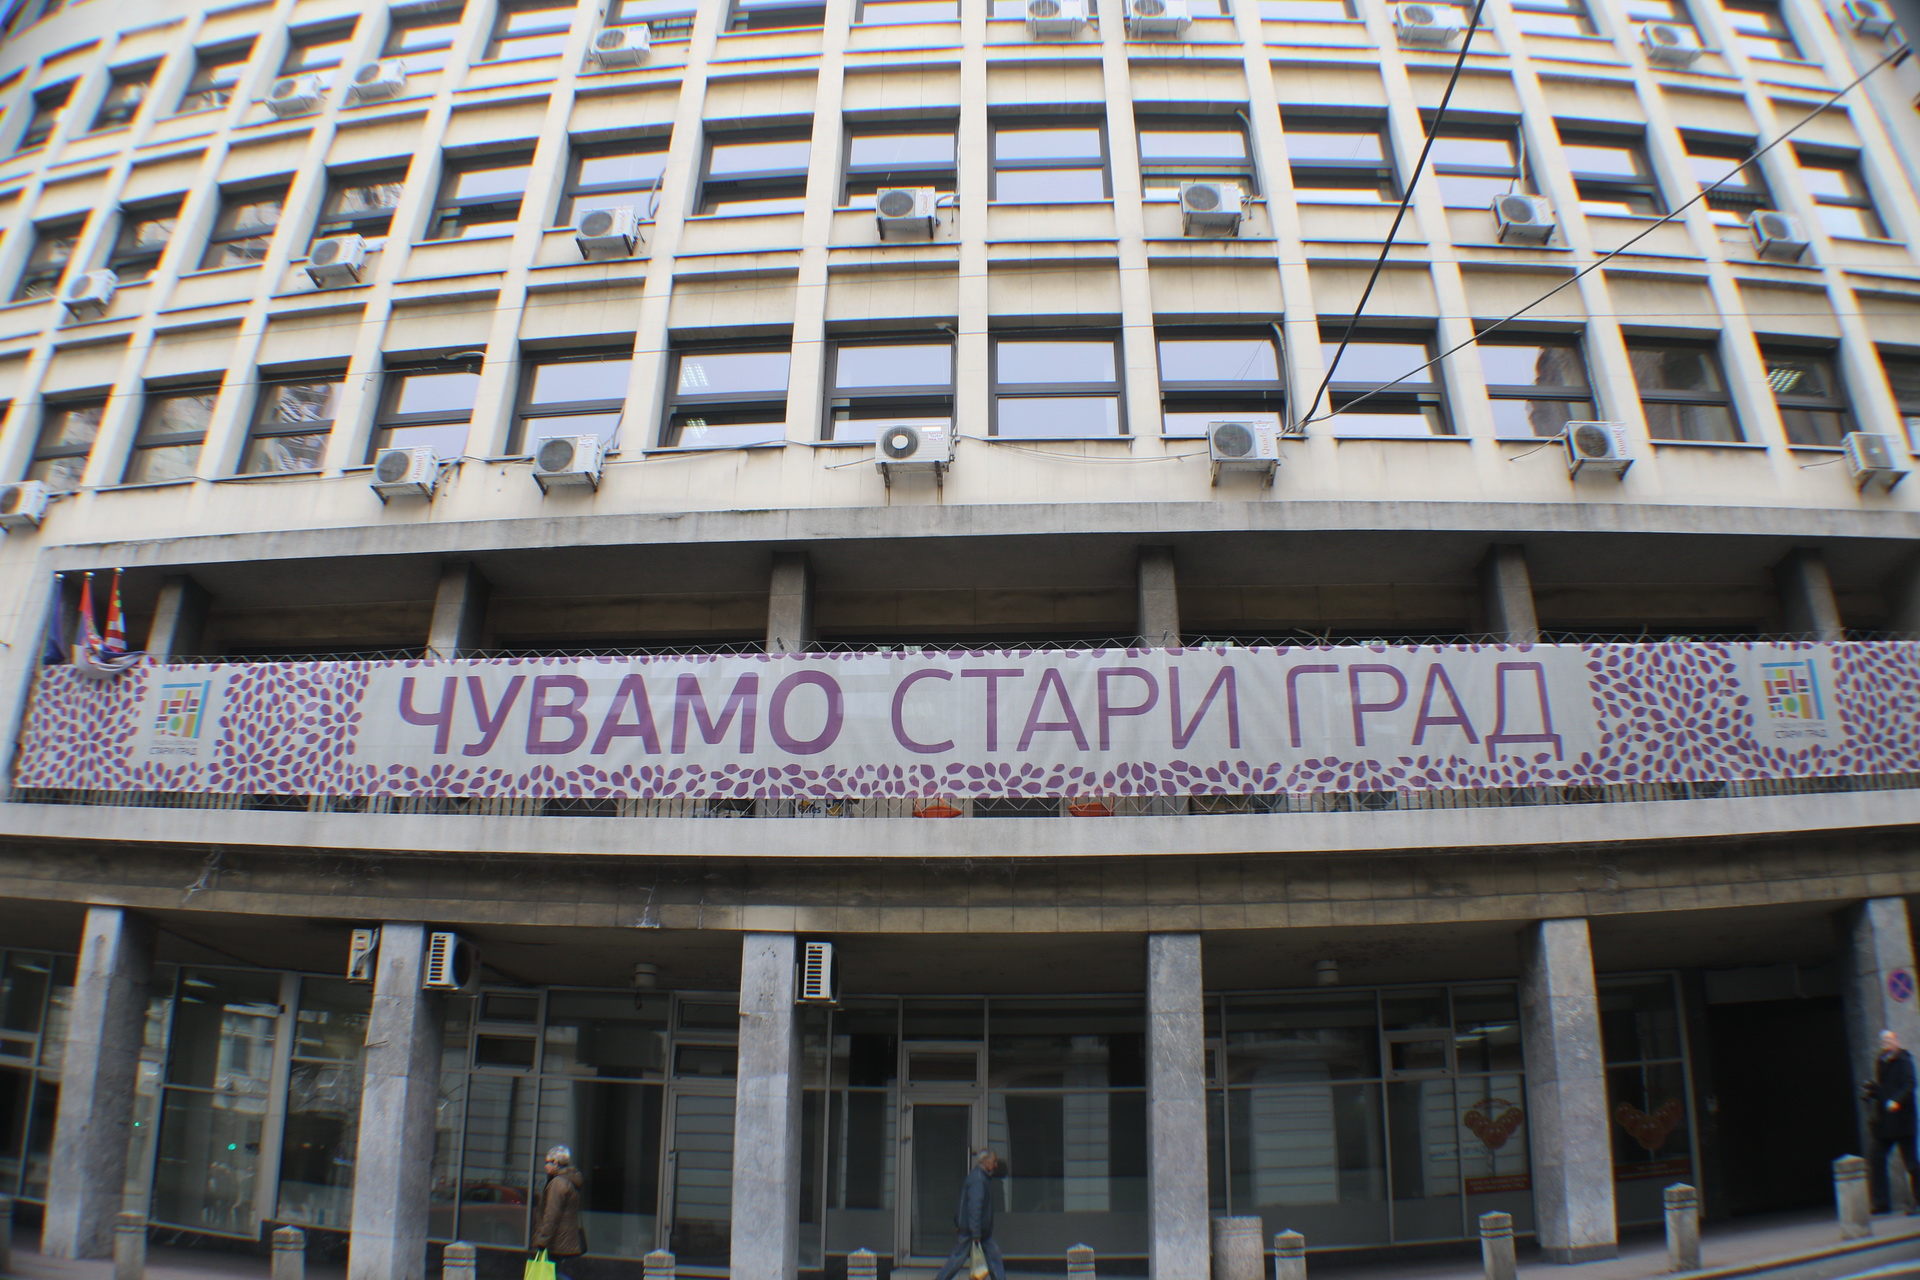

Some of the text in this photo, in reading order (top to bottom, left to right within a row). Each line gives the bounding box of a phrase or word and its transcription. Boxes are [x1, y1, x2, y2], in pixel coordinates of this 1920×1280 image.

[400, 662, 1564, 762] ЧУВАМО СТАРИ ГРАД
